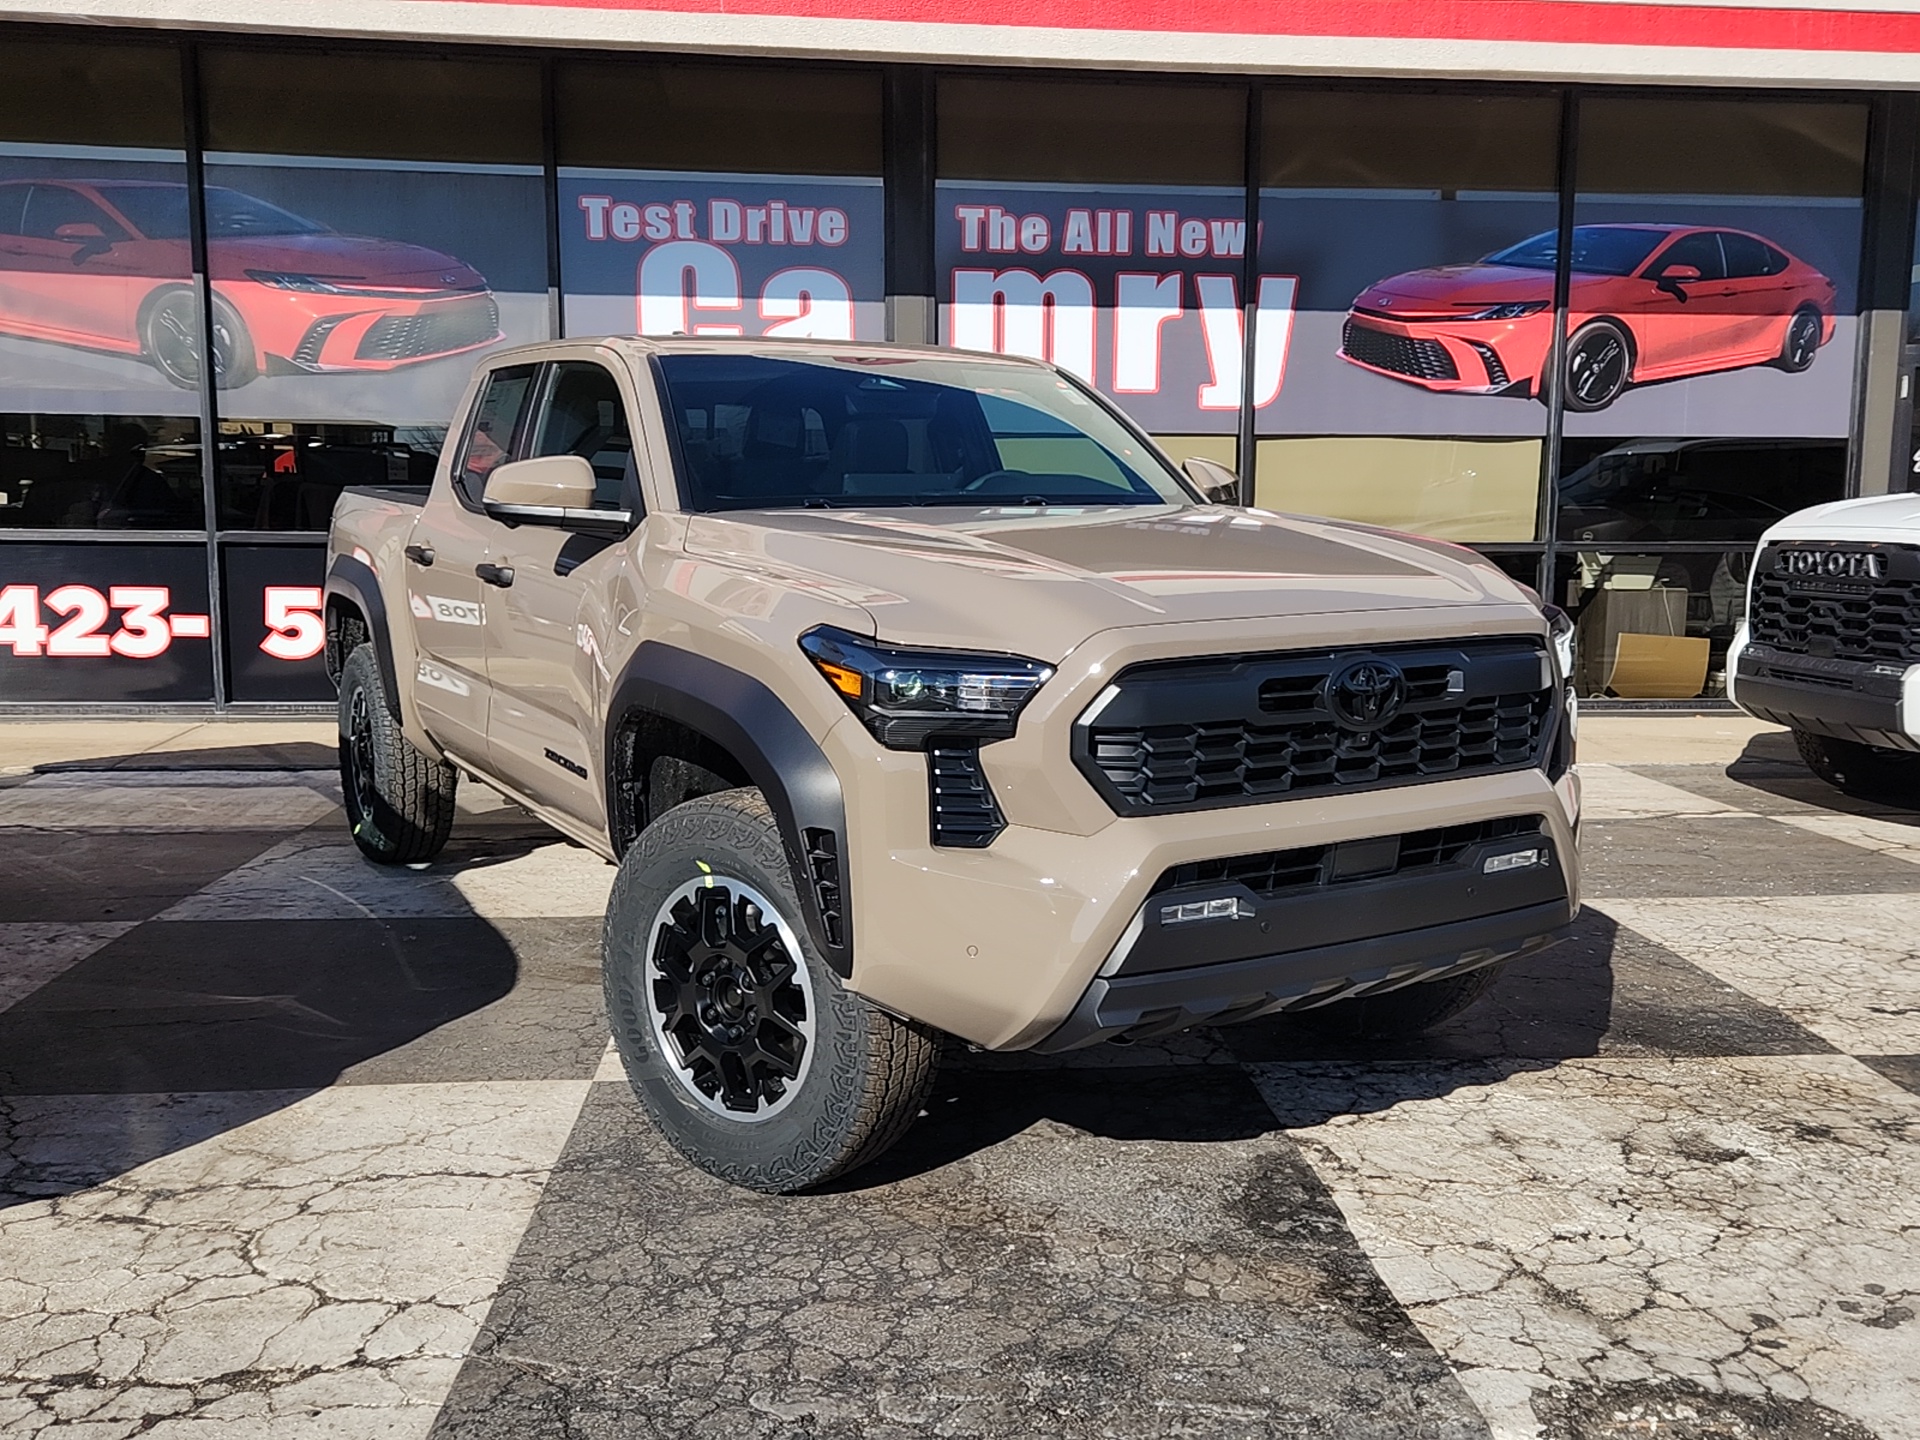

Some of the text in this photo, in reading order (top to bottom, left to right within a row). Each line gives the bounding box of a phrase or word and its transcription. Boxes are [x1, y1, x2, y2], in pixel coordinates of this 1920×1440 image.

[578, 195, 1263, 259] Test Drive The All New
[1786, 552, 1880, 578] TOYOTA
[0, 584, 209, 659] 423-
